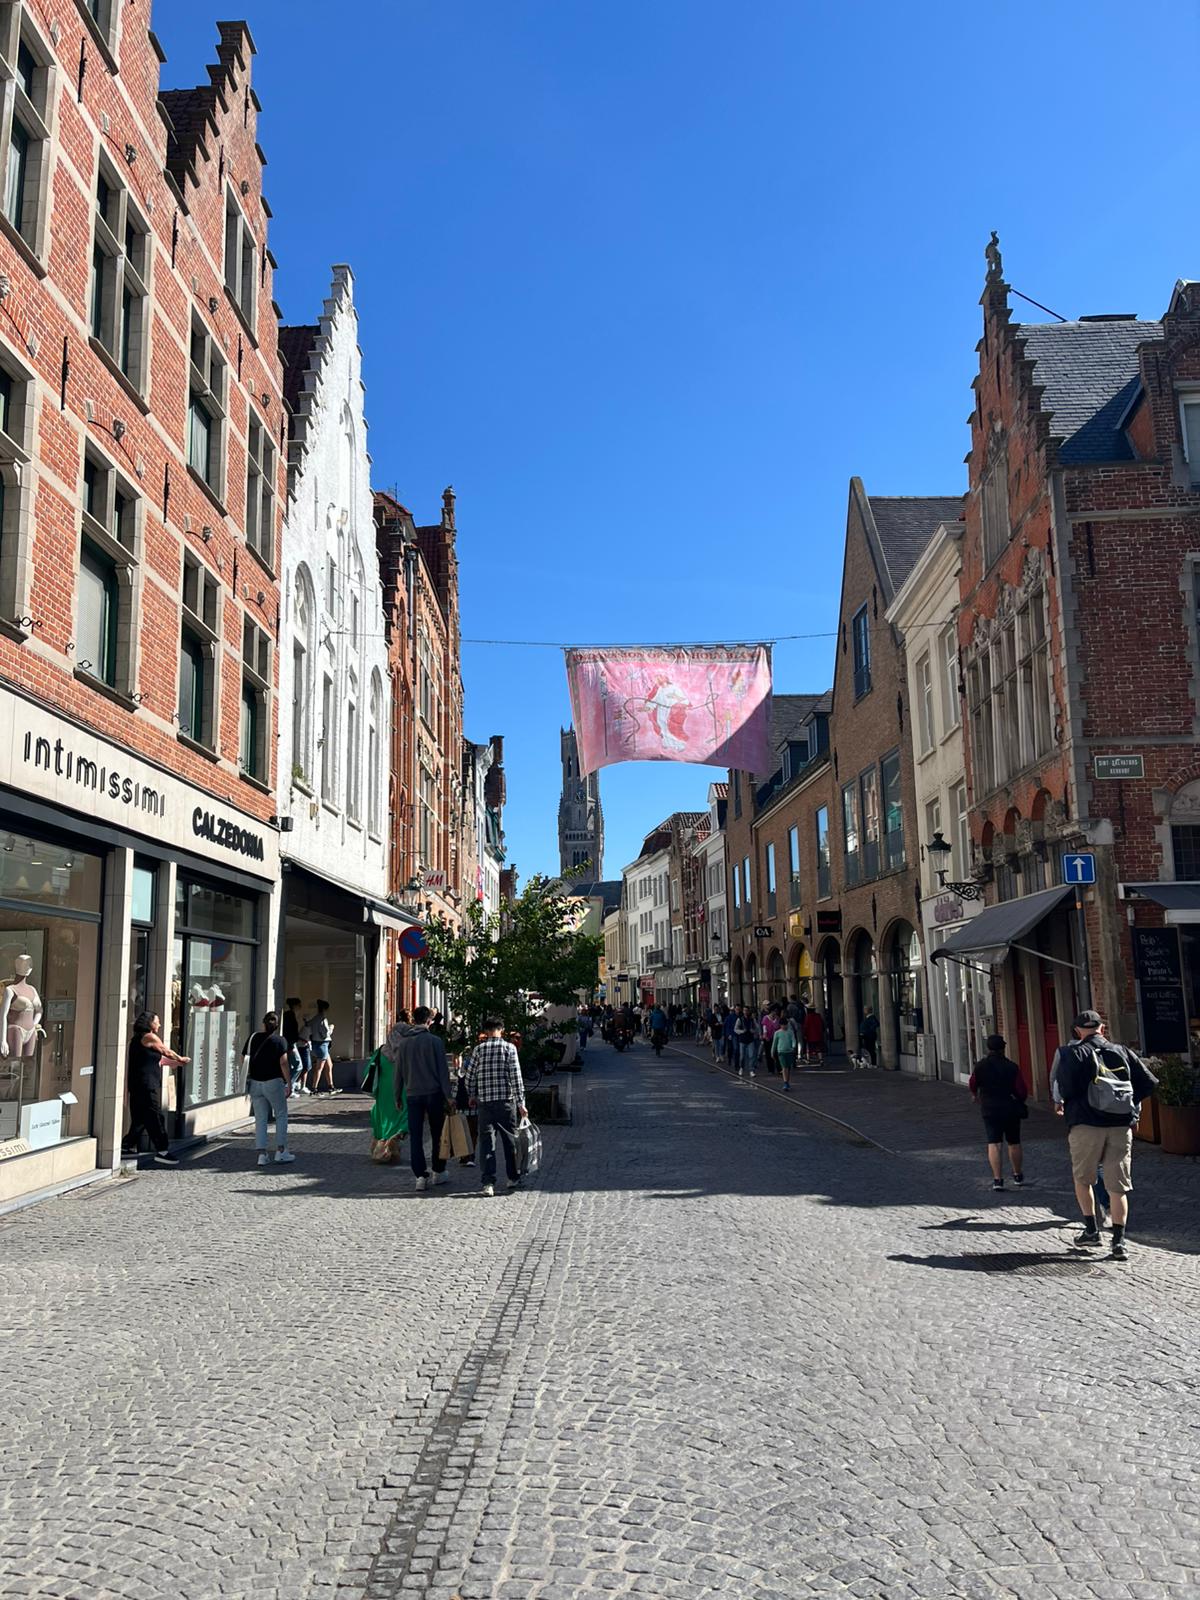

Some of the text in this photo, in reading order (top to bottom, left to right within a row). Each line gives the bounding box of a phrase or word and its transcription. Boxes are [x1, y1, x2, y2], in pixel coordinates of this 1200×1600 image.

[691, 651, 721, 660] HOLY
[192, 807, 264, 862] CALZEDONIA
[0, 1143, 27, 1158] ssimi
